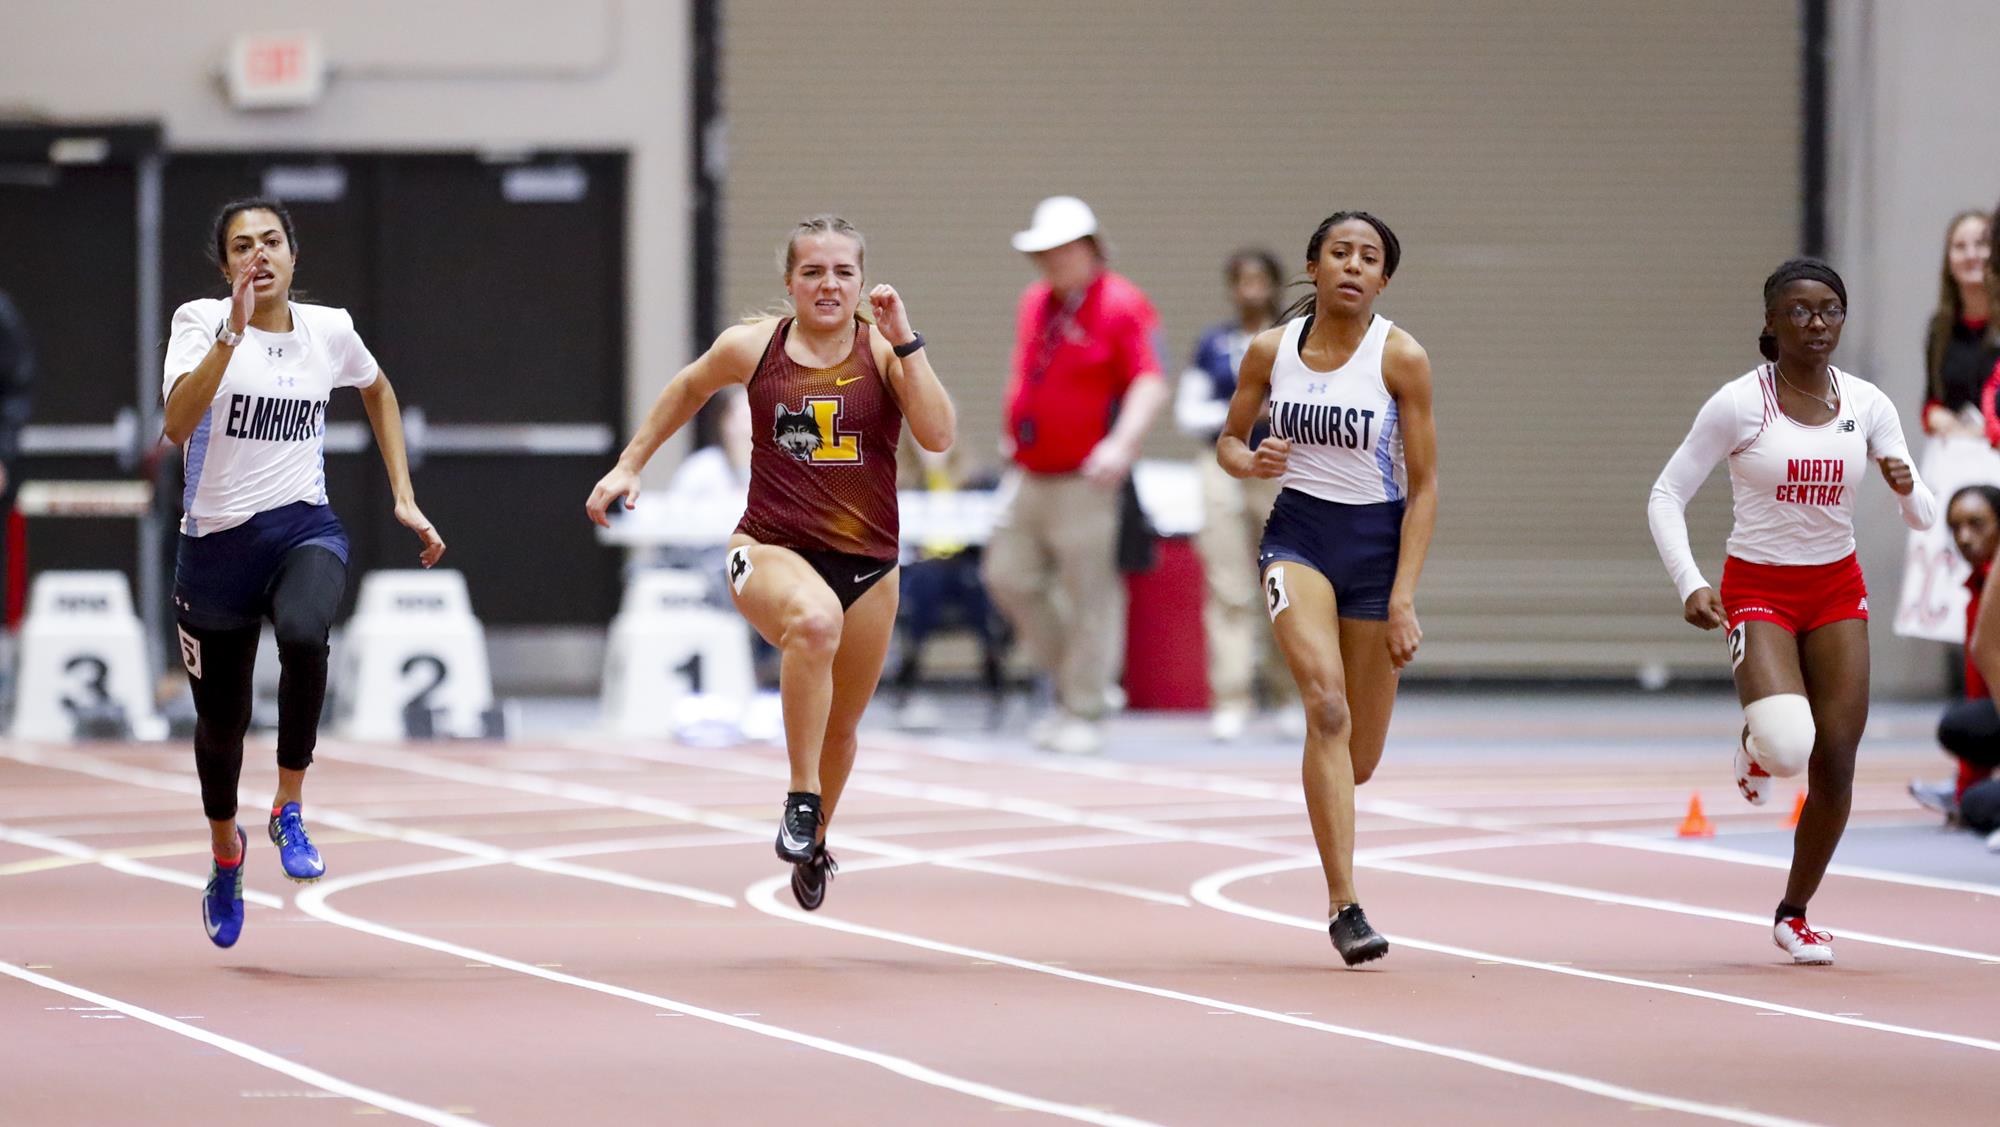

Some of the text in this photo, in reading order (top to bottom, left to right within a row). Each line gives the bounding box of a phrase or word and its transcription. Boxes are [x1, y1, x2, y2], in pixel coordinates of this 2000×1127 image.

[1270, 401, 1374, 450] LMHURST
[1787, 459, 1844, 482] NORTH
[1776, 484, 1845, 506] CENTRAL
[731, 551, 746, 584] 4
[1268, 576, 1280, 612] 3
[183, 636, 197, 667] 5
[1730, 629, 1741, 664] 2
[62, 655, 109, 711] 3
[402, 655, 448, 713] 2
[673, 652, 703, 693] 1
